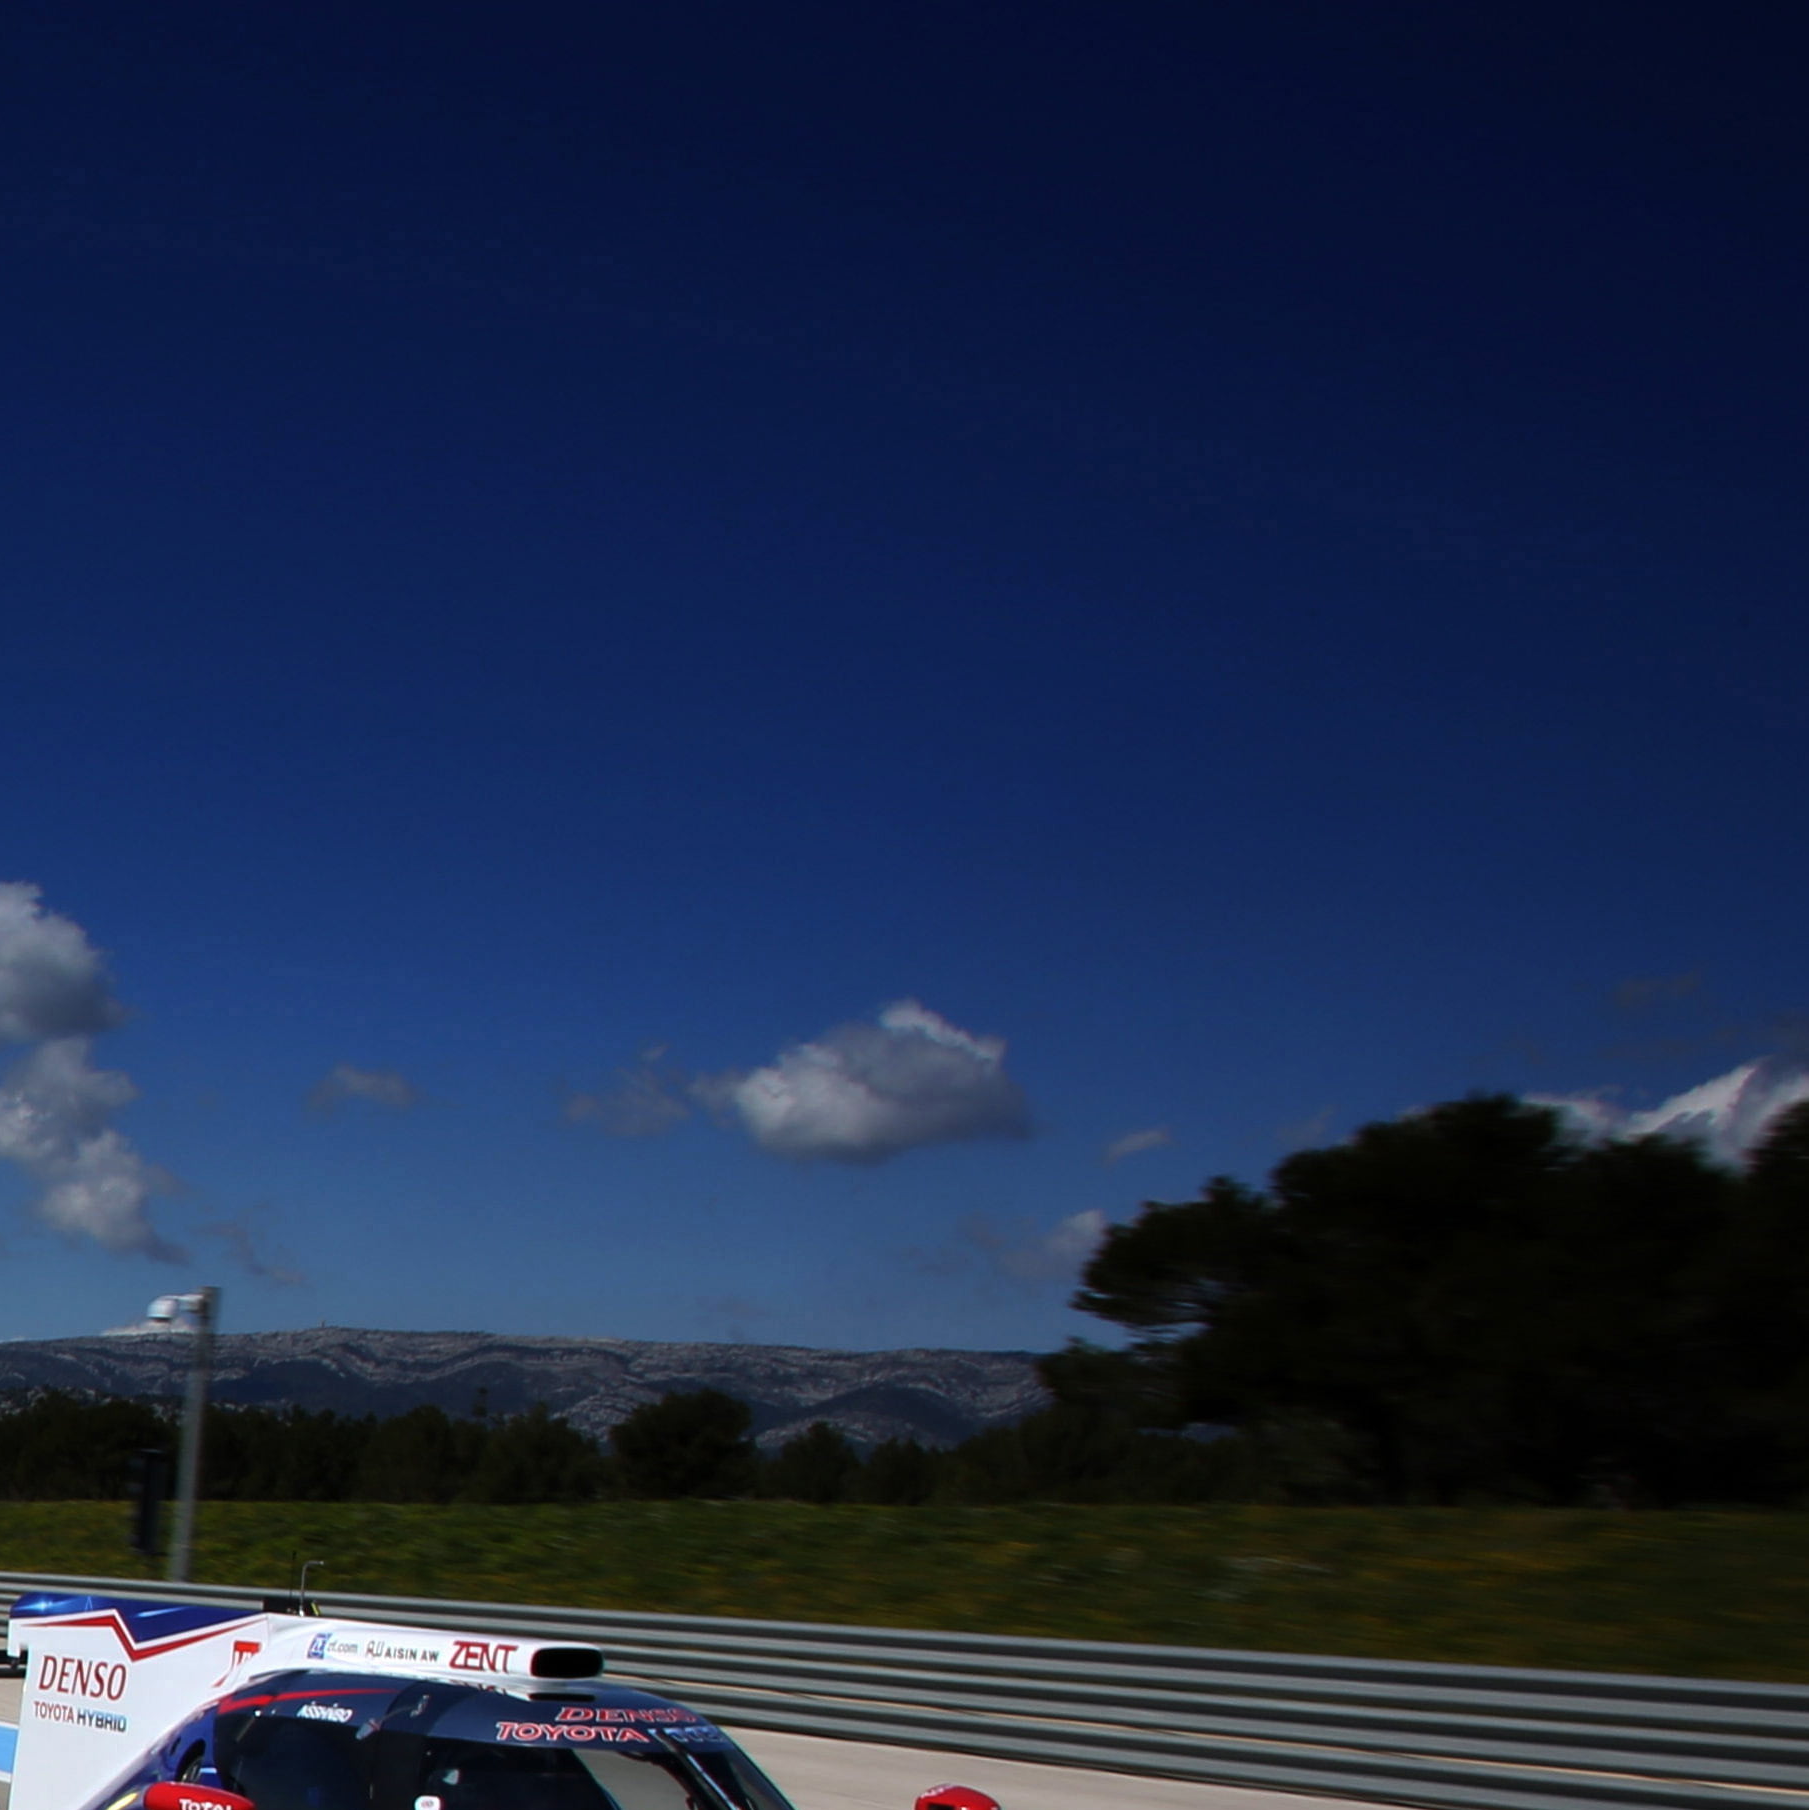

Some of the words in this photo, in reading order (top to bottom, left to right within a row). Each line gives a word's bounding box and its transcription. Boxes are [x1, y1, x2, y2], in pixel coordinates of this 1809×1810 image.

[384, 1645, 418, 1661] AISIN
[448, 1640, 520, 1674] ZENT
[38, 1654, 127, 1701] DENSO
[33, 1700, 75, 1724] TOYOTA
[76, 1707, 128, 1733] HYBRID
[495, 1720, 651, 1743] TOYOTA
